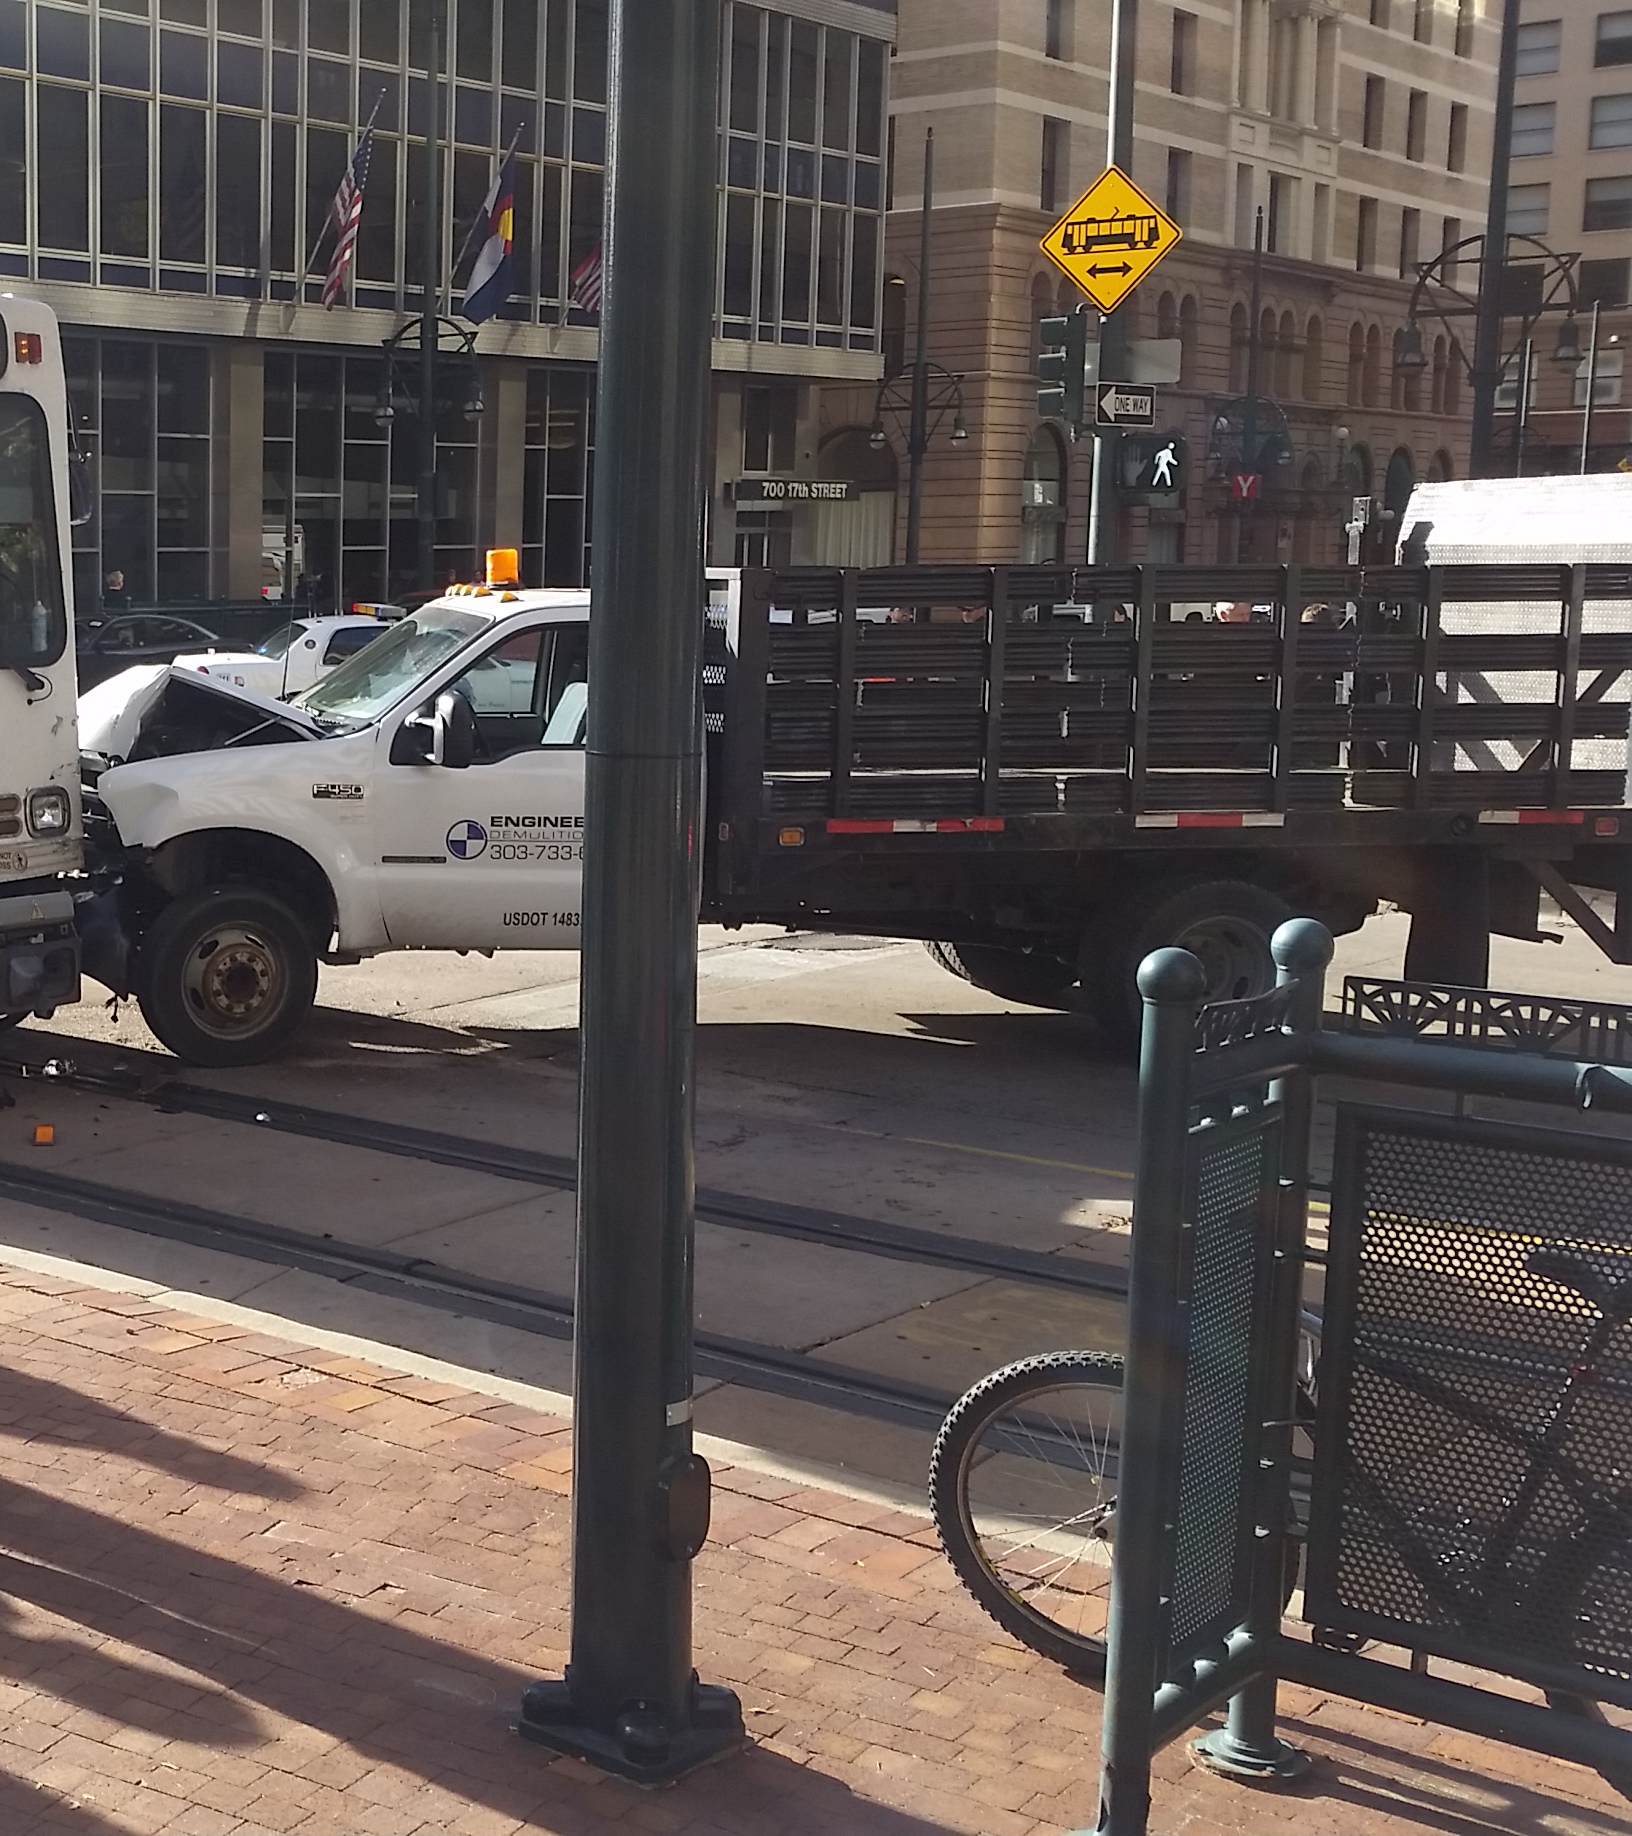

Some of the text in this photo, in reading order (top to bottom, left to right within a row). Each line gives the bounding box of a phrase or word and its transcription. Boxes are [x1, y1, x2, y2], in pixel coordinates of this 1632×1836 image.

[1114, 397, 1149, 413] ONE WAY
[762, 481, 848, 499] 700 17th STREET
[1237, 475, 1255, 497] Y
[490, 816, 584, 828] ENGINEE
[503, 912, 583, 927] USDOT 1483
